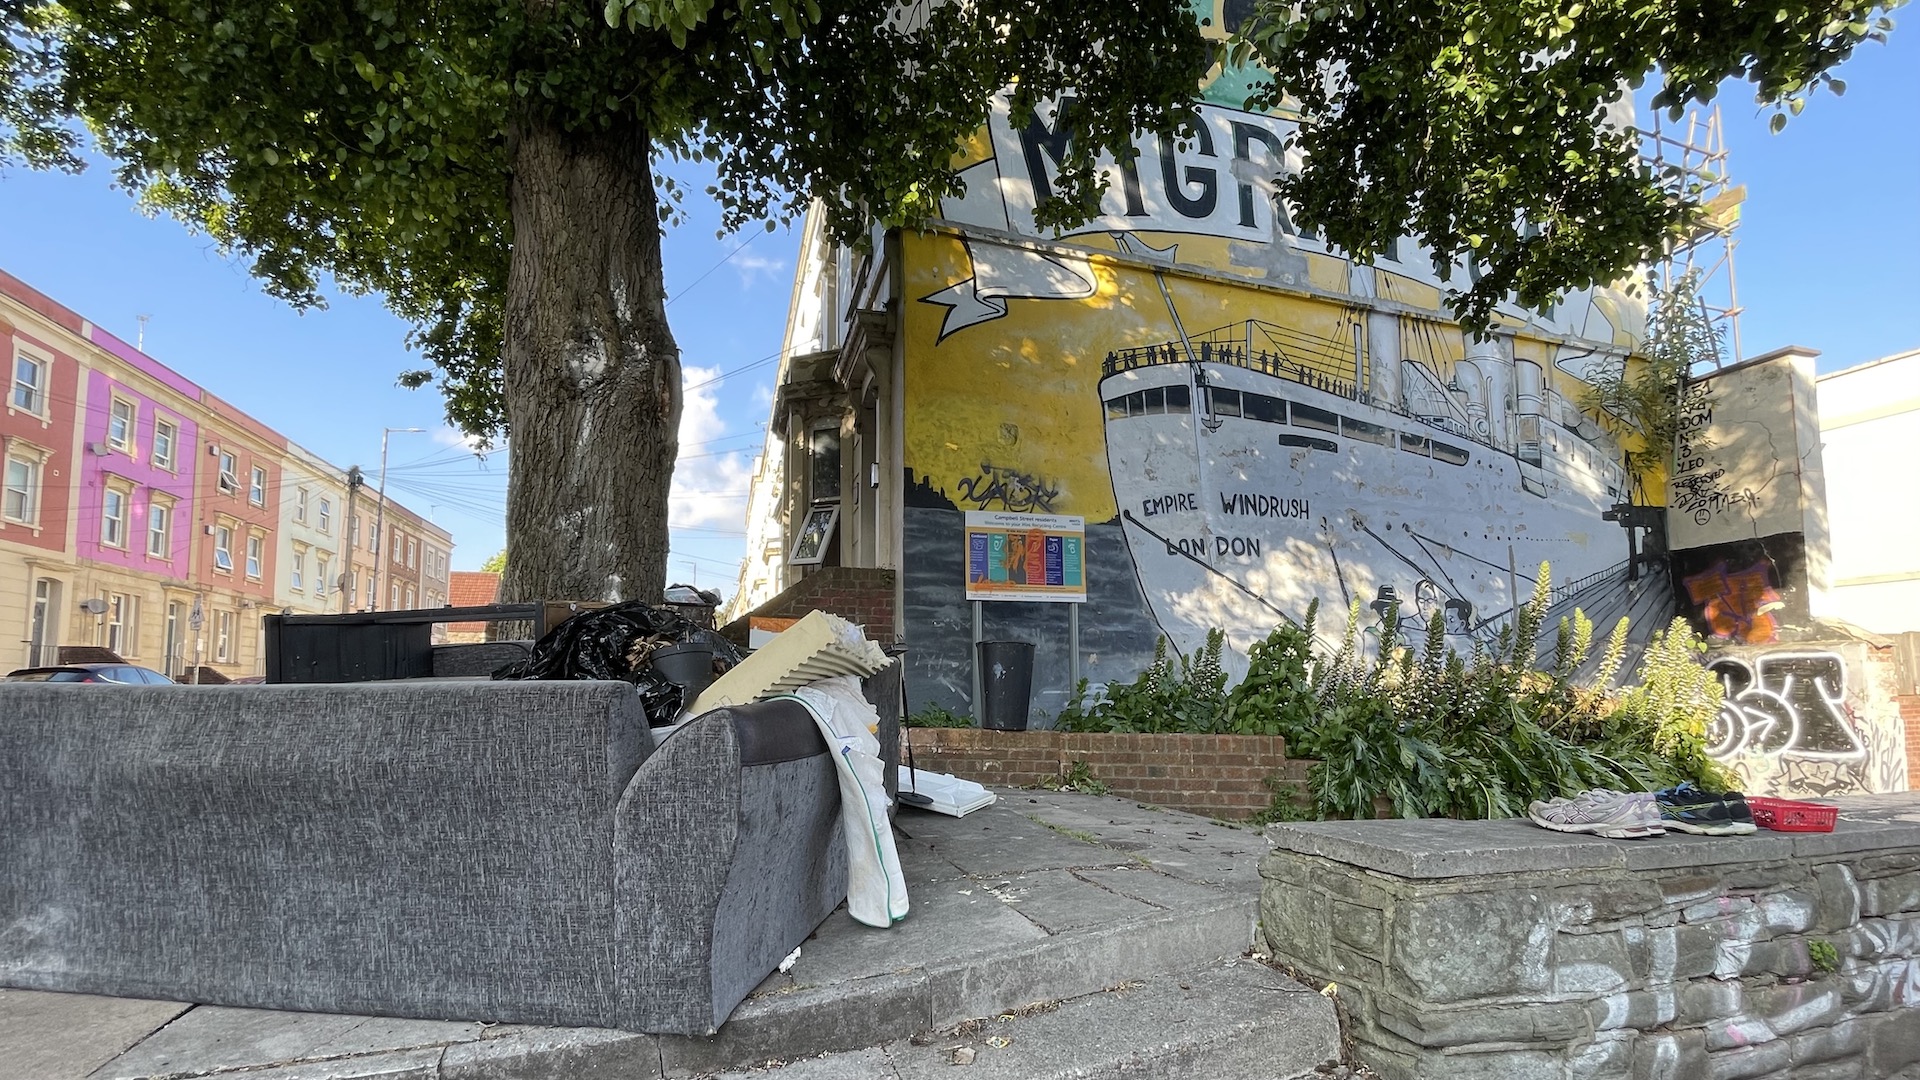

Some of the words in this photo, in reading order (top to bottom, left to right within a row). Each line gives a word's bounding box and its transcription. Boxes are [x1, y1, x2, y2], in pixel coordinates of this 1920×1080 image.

[1142, 493, 1198, 517] EMPIRE
[1220, 492, 1309, 520] WINDRUSH
[994, 514, 1018, 523] Campbell
[1035, 516, 1057, 524] residents
